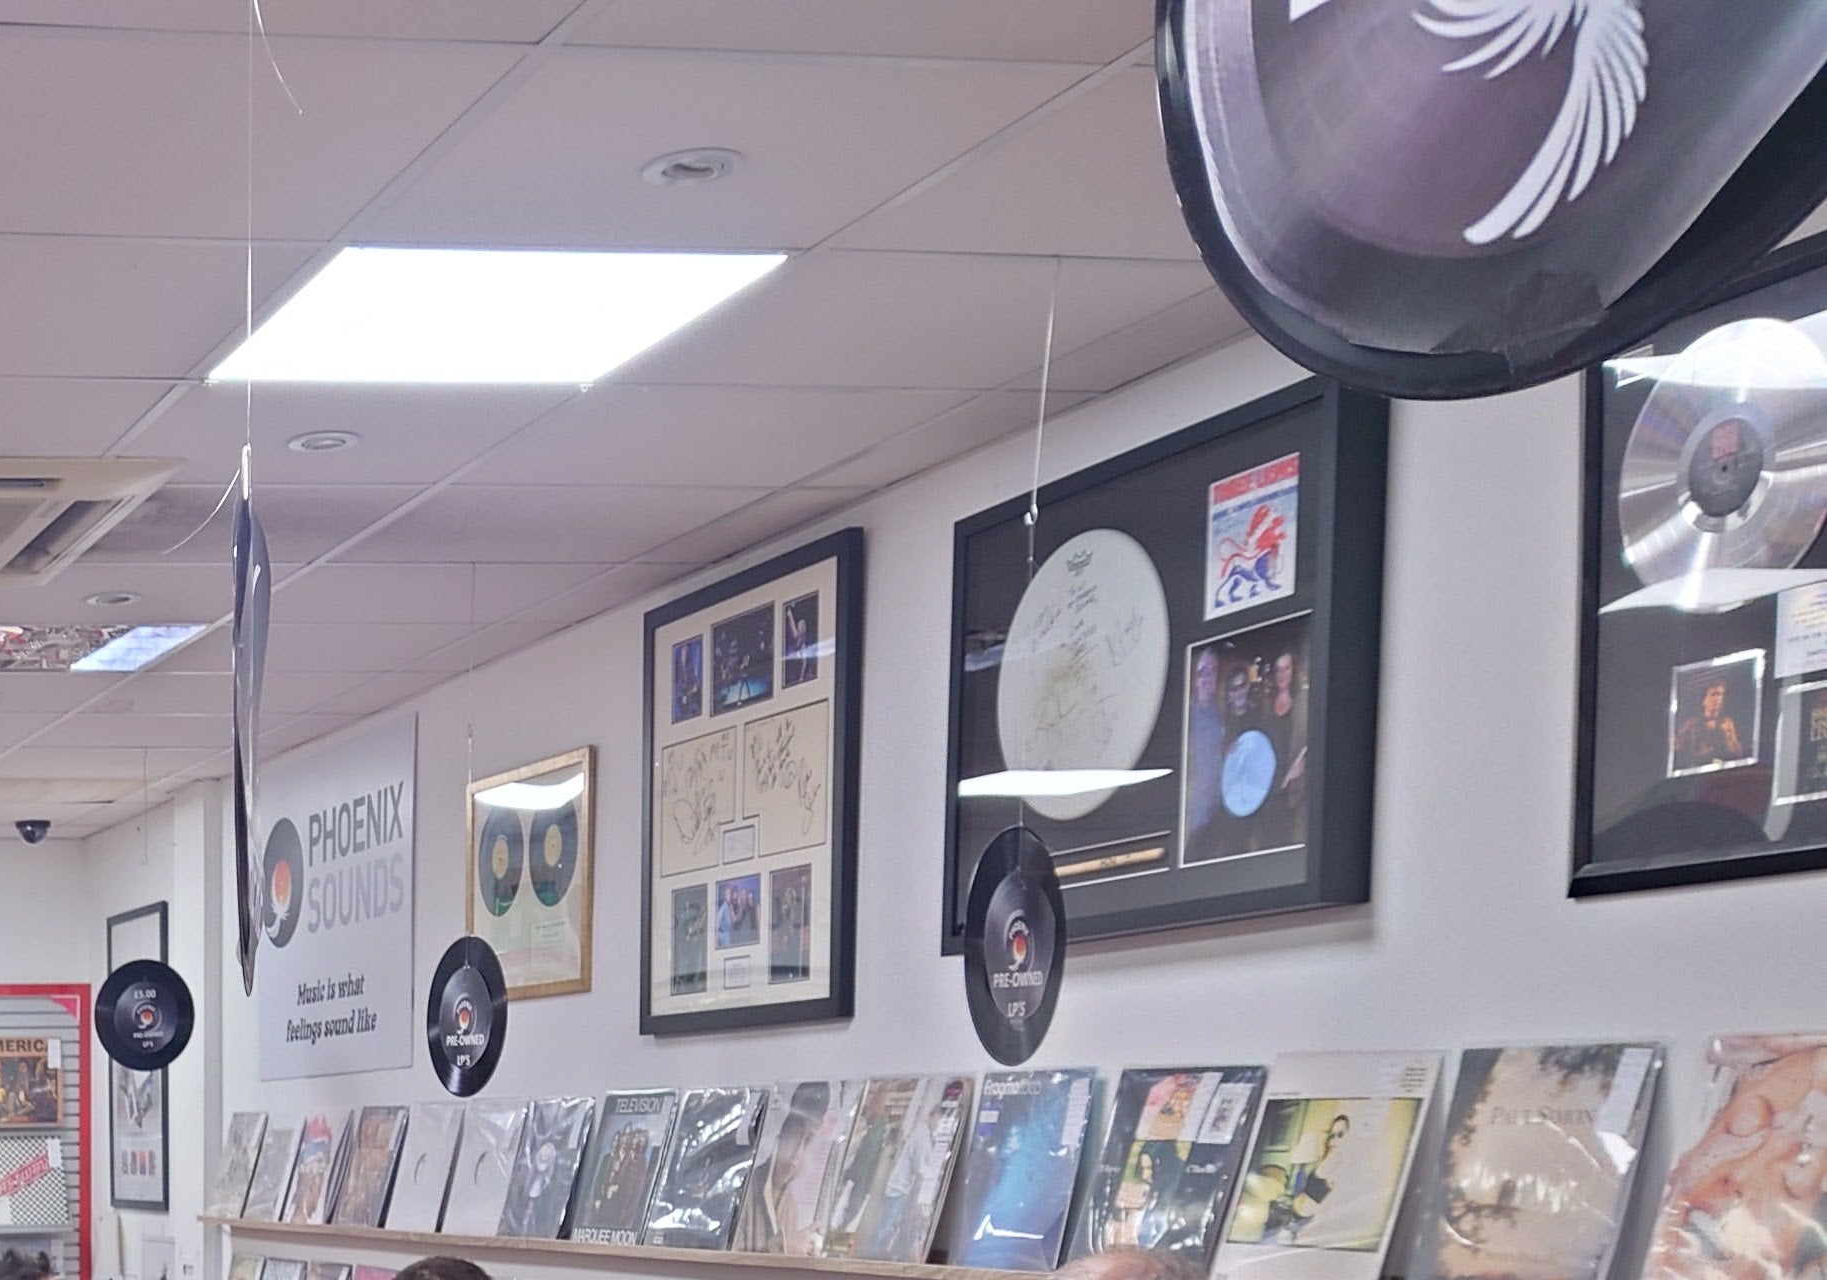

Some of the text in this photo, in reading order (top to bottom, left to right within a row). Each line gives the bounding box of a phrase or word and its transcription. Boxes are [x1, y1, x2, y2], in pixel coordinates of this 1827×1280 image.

[309, 780, 405, 867] PHOENIX
[307, 852, 405, 934] SOUNDS
[993, 970, 1044, 989] PRE-OWNED
[297, 973, 365, 1006] Music is what
[1007, 1002, 1027, 1017] LP'S
[286, 1008, 377, 1044] feelings sound like
[446, 1033, 485, 1047] PRE-OWNED
[615, 1098, 662, 1114] TELEVISION
[573, 1228, 638, 1246] MARQUEE MOON
